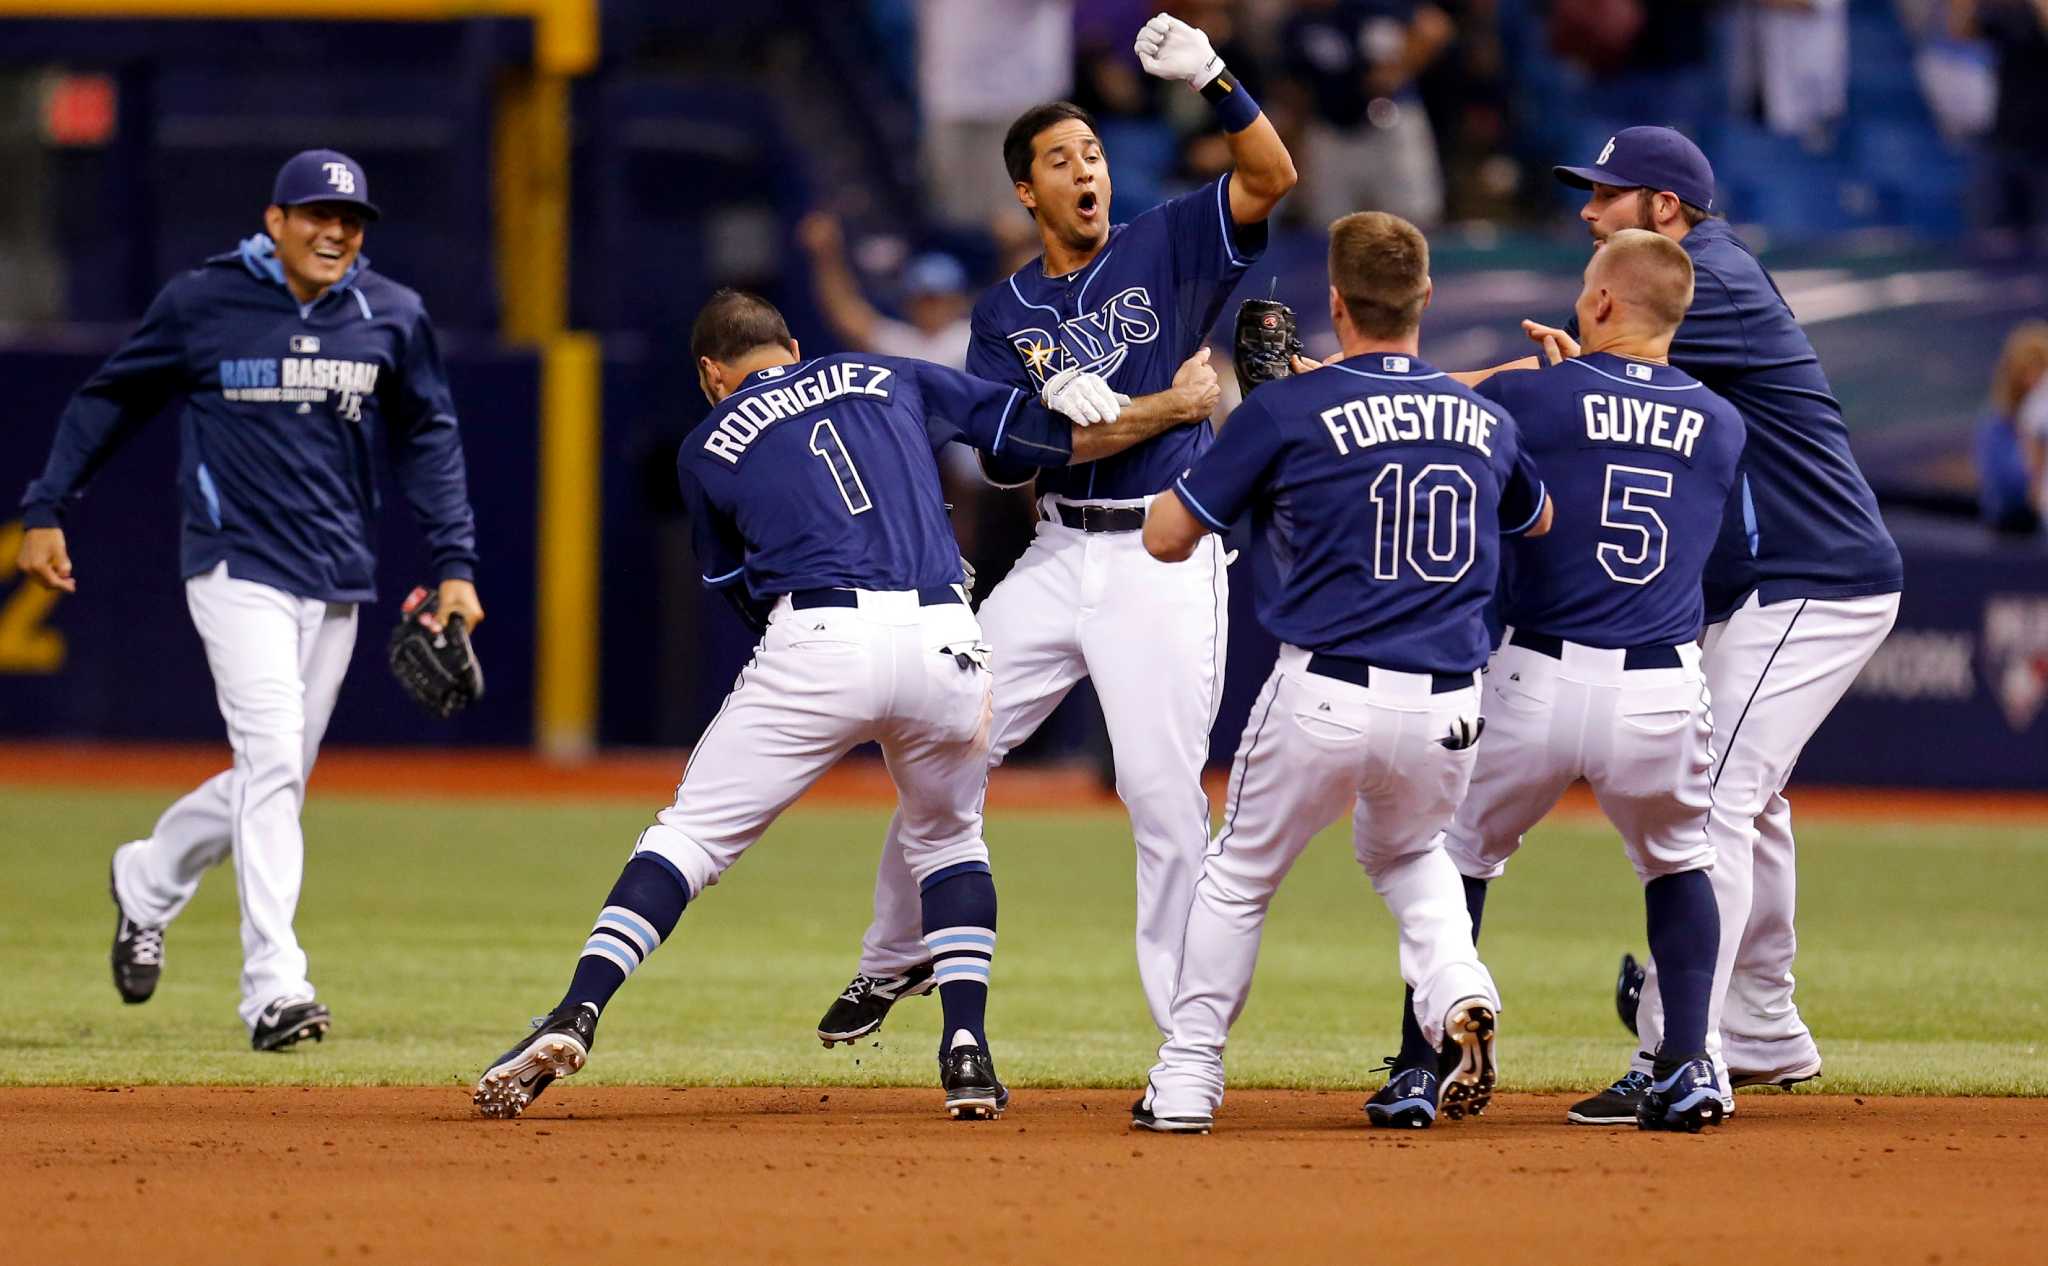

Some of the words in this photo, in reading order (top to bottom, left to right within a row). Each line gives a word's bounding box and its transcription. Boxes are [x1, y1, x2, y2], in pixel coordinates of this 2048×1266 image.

[322, 162, 355, 194] TB
[220, 358, 278, 388] RAYS
[1007, 287, 1160, 394] RAYS
[703, 362, 892, 465] RODRIGUEZ
[1320, 394, 1498, 458] FORSYTHE
[1582, 394, 1705, 458] GUYER
[809, 418, 873, 516] 1
[1369, 462, 1477, 584] 10
[1596, 463, 1674, 585] 5
